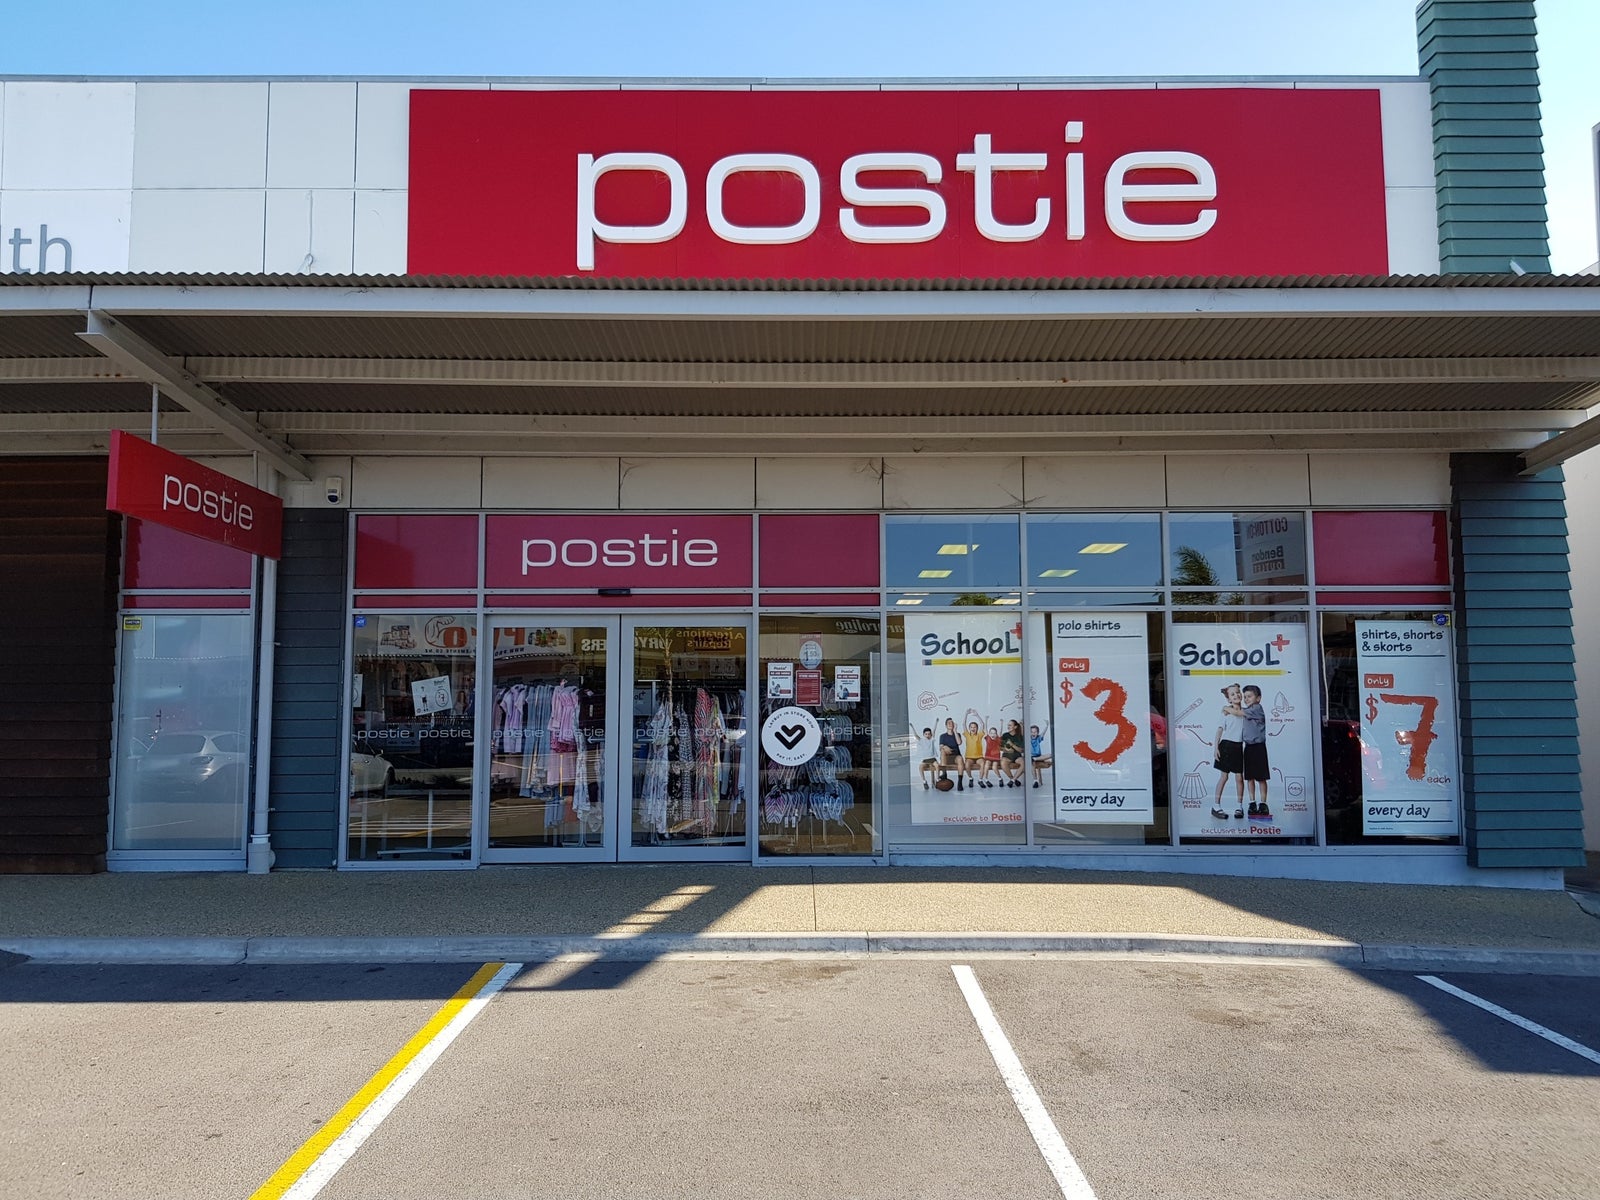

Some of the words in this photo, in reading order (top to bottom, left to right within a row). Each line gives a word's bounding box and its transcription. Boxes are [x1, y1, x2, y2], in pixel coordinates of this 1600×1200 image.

[576, 121, 1218, 270] postie
[162, 474, 254, 531] postie
[521, 528, 718, 575] postie
[1058, 620, 1081, 634] polo
[1084, 620, 1121, 631] shirts
[1361, 629, 1400, 640] shirts,
[1361, 641, 1371, 652] &
[1373, 641, 1413, 652] skorts
[357, 727, 410, 741] postie
[418, 726, 471, 741] postie
[492, 727, 545, 741] postie
[823, 724, 874, 739] postie
[1427, 775, 1451, 784] each
[1062, 794, 1098, 807] every
[1100, 792, 1126, 807] day
[943, 815, 978, 823] exclusive
[991, 812, 1023, 822] Postie
[1368, 806, 1404, 819] every
[1406, 803, 1431, 819] day
[1249, 825, 1282, 835] Postie
